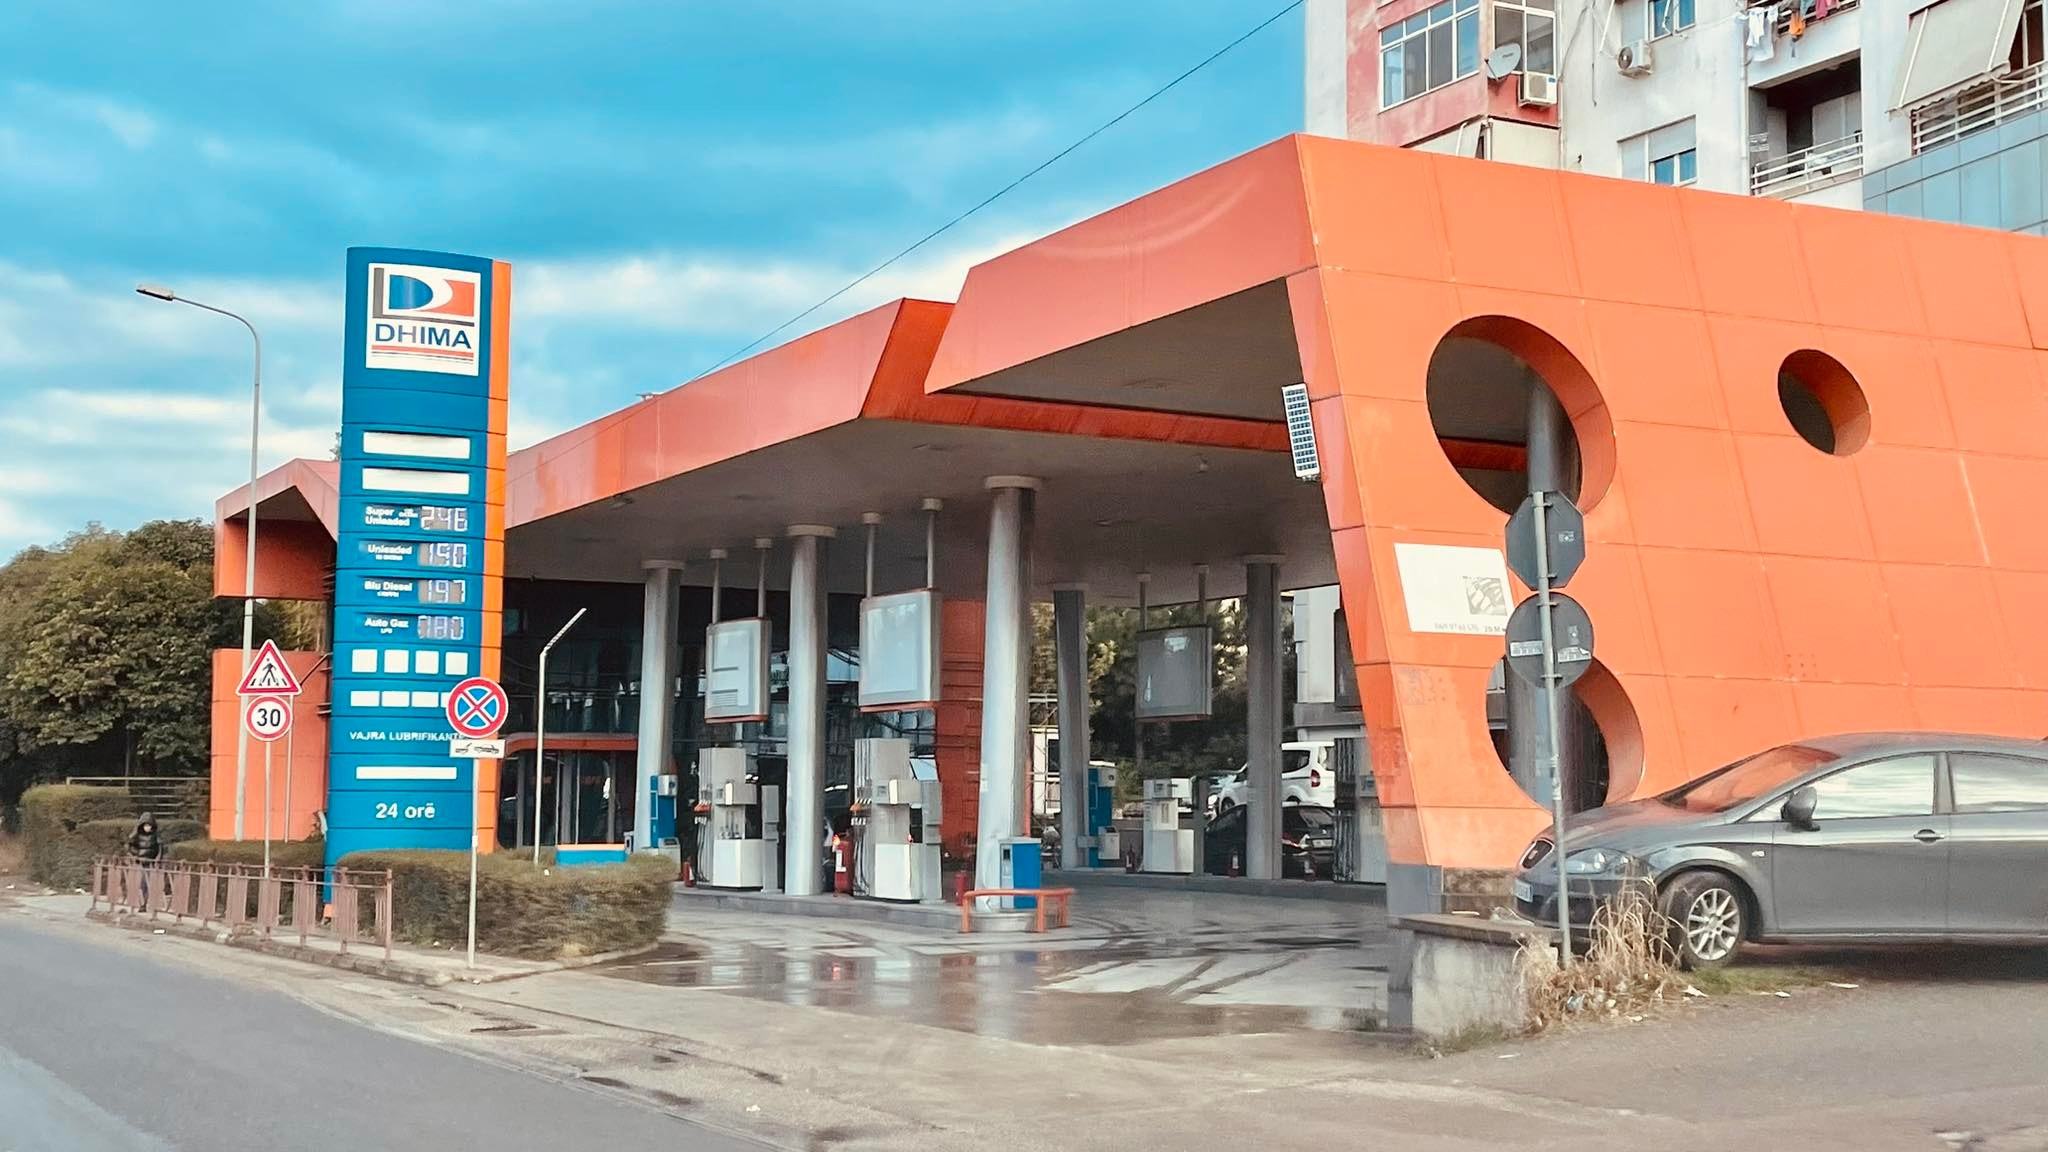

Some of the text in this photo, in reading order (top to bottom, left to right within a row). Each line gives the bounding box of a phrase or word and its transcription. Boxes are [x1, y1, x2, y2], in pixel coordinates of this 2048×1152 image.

[375, 323, 472, 349] DHIMA
[366, 506, 395, 518] Super
[365, 516, 411, 526] Unleaded
[420, 506, 468, 532] 246
[368, 544, 412, 554] Unleaded
[383, 582, 413, 591] Diesel
[428, 579, 466, 603] 197
[364, 617, 409, 628] Auto Gaz
[256, 708, 281, 727] 30
[349, 732, 386, 740] VAJRA
[376, 802, 435, 819] 24 orë
